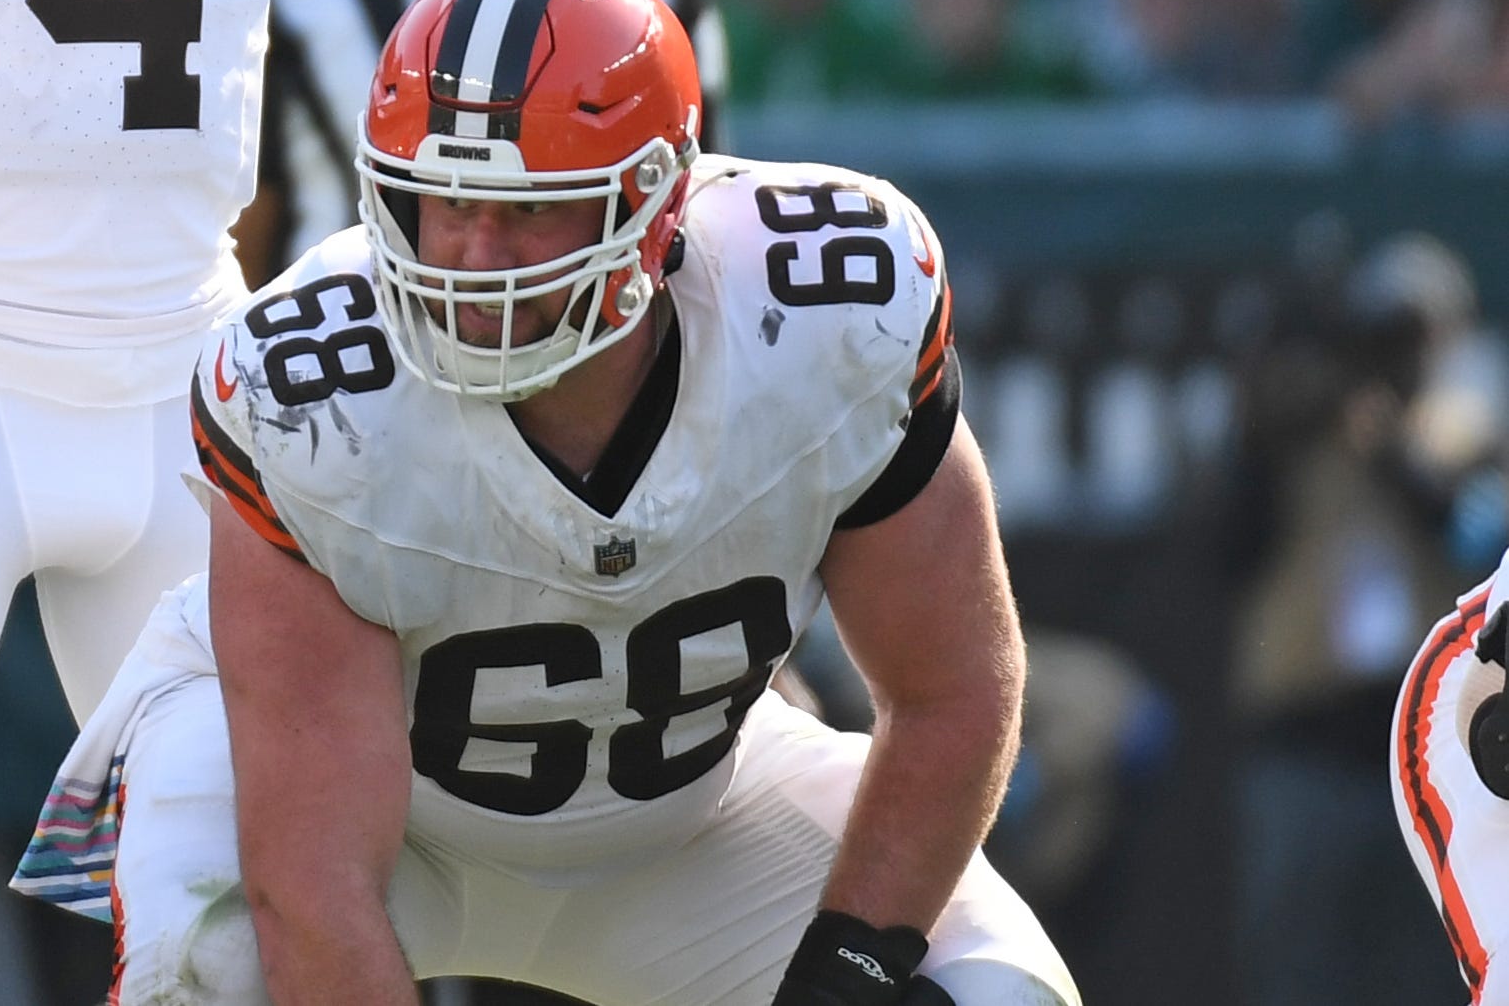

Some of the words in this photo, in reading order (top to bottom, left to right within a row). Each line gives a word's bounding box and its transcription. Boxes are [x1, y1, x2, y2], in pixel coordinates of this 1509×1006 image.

[438, 143, 491, 162] BROWNS
[755, 181, 895, 307] 68
[244, 273, 395, 407] 68
[409, 575, 793, 816] 68
